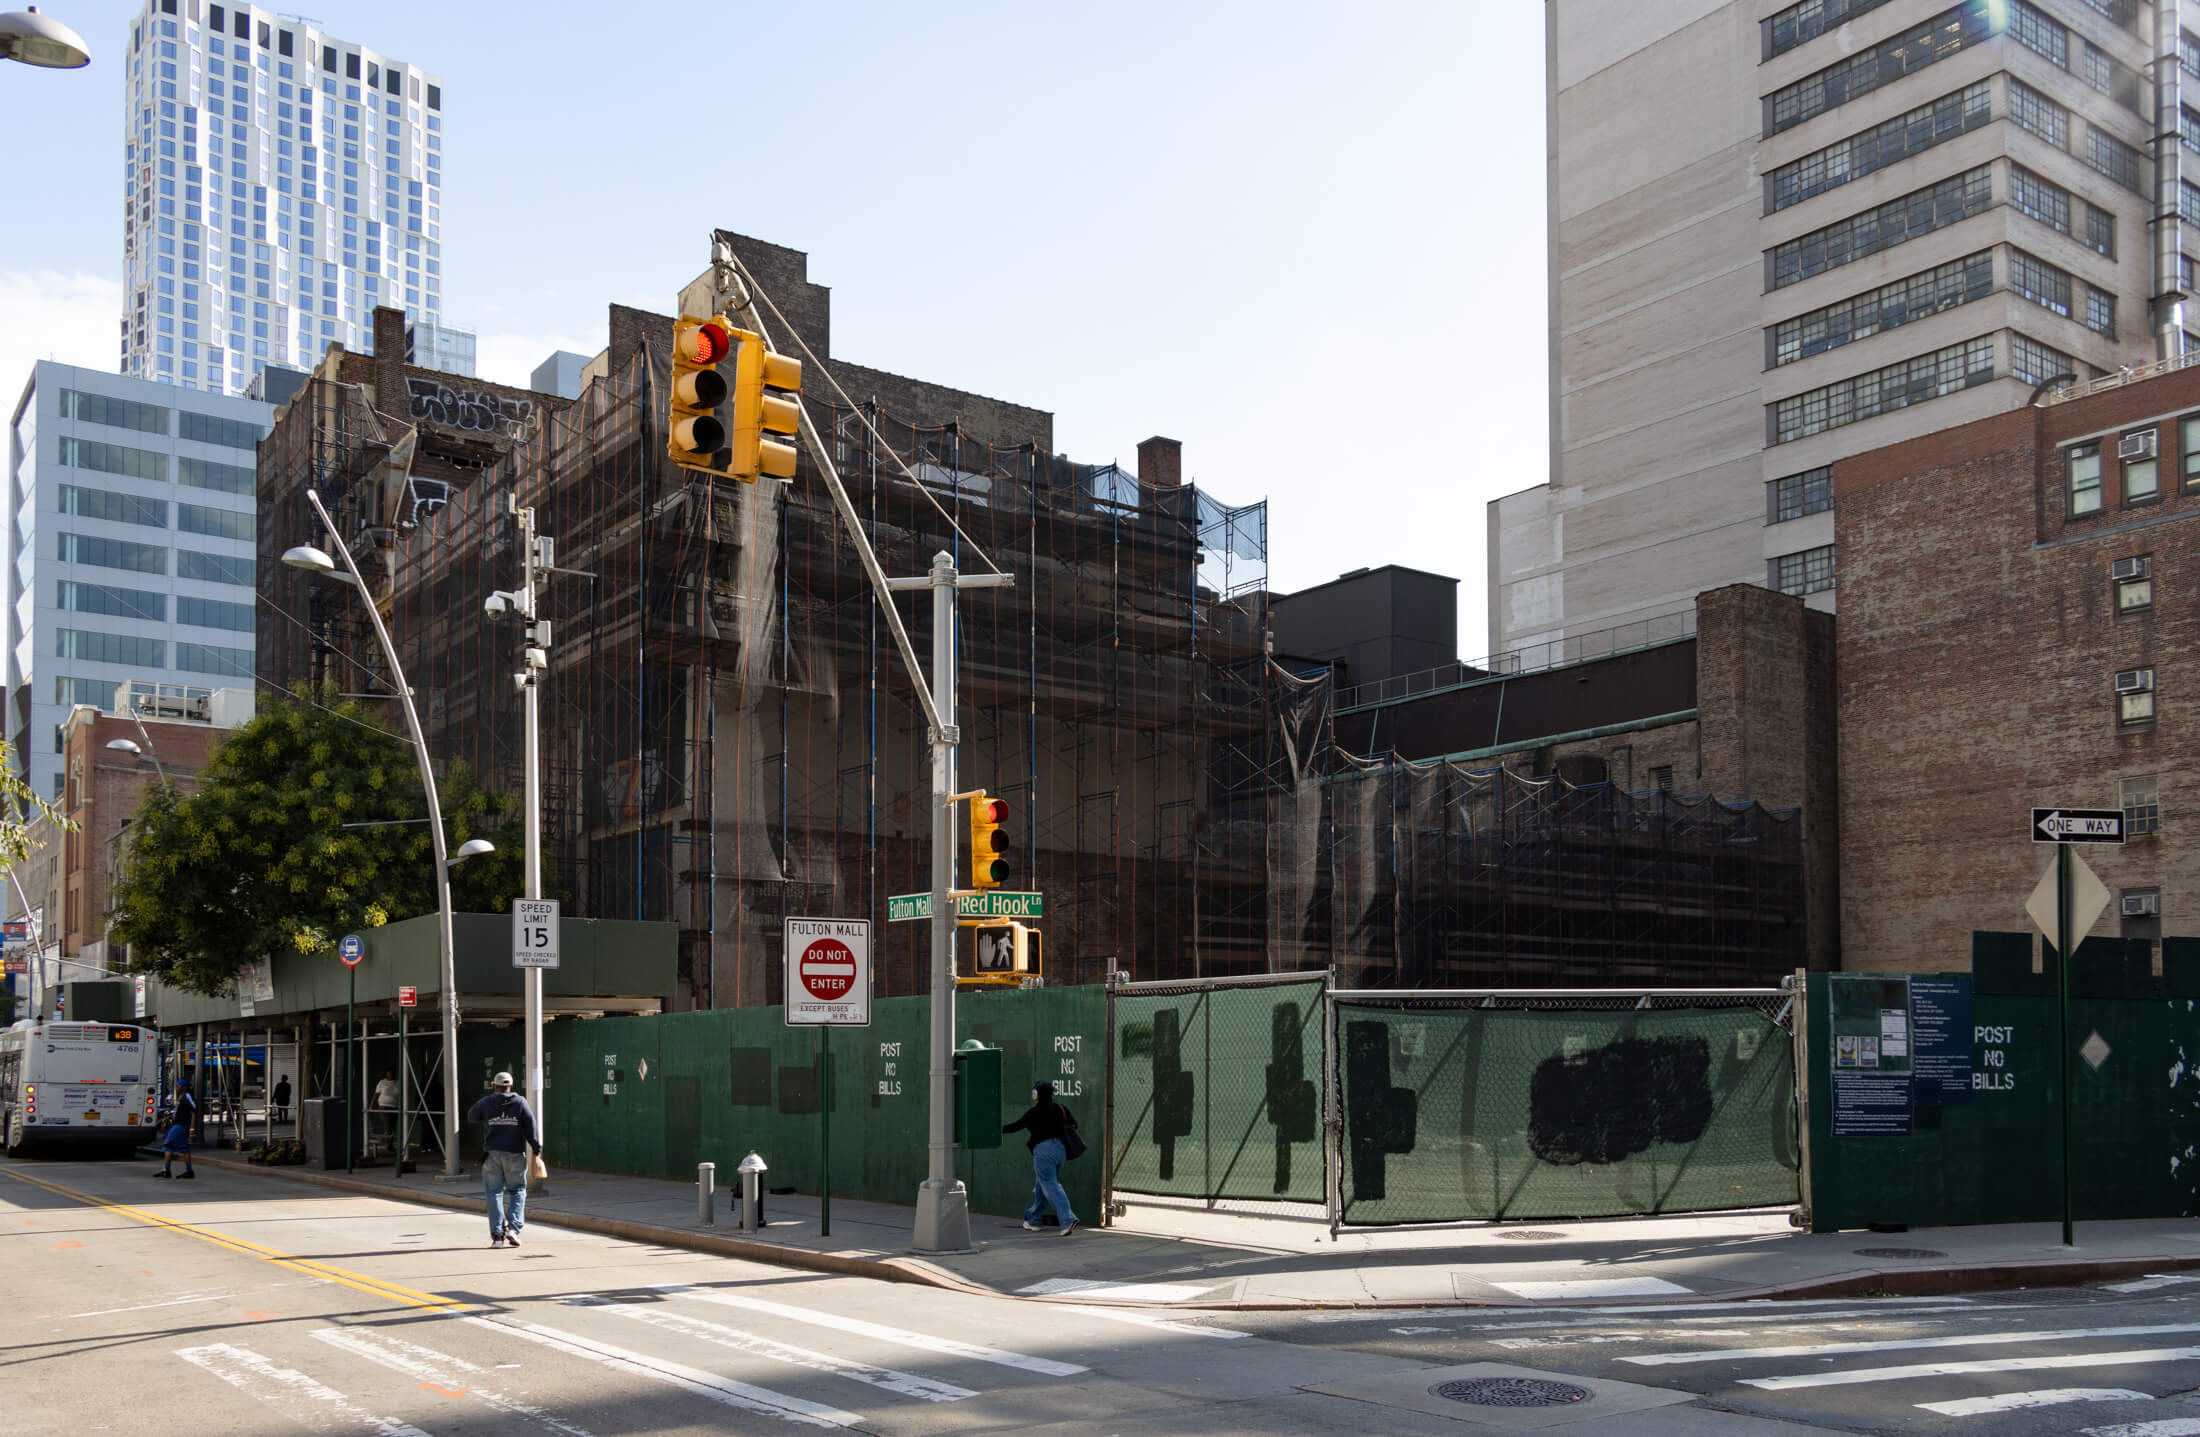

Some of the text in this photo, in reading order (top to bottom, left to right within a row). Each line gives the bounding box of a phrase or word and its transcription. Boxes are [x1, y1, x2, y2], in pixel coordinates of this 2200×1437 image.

[2047, 819, 2112, 833] ONE WAY
[520, 903, 552, 914] SPEED
[890, 896, 933, 918] Fulton Mall
[960, 895, 1042, 914] Red Hook Ln
[523, 914, 548, 924] LIMIT
[523, 927, 549, 948] 15
[792, 923, 864, 937] FULTON MALL
[808, 949, 848, 961] DO NOT
[810, 978, 846, 990] ENTER
[800, 1005, 849, 1014] EXCEPT BUSES
[1974, 1026, 2014, 1043] POST
[880, 1042, 902, 1057] POST
[1054, 1035, 1082, 1053] POST
[1060, 1058, 1075, 1074] NO
[1984, 1049, 2005, 1067] NO
[885, 1062, 896, 1077] NO
[878, 1080, 901, 1096] BILLS
[1052, 1079, 1082, 1096] BILLS
[1972, 1072, 2014, 1090] BILLS
